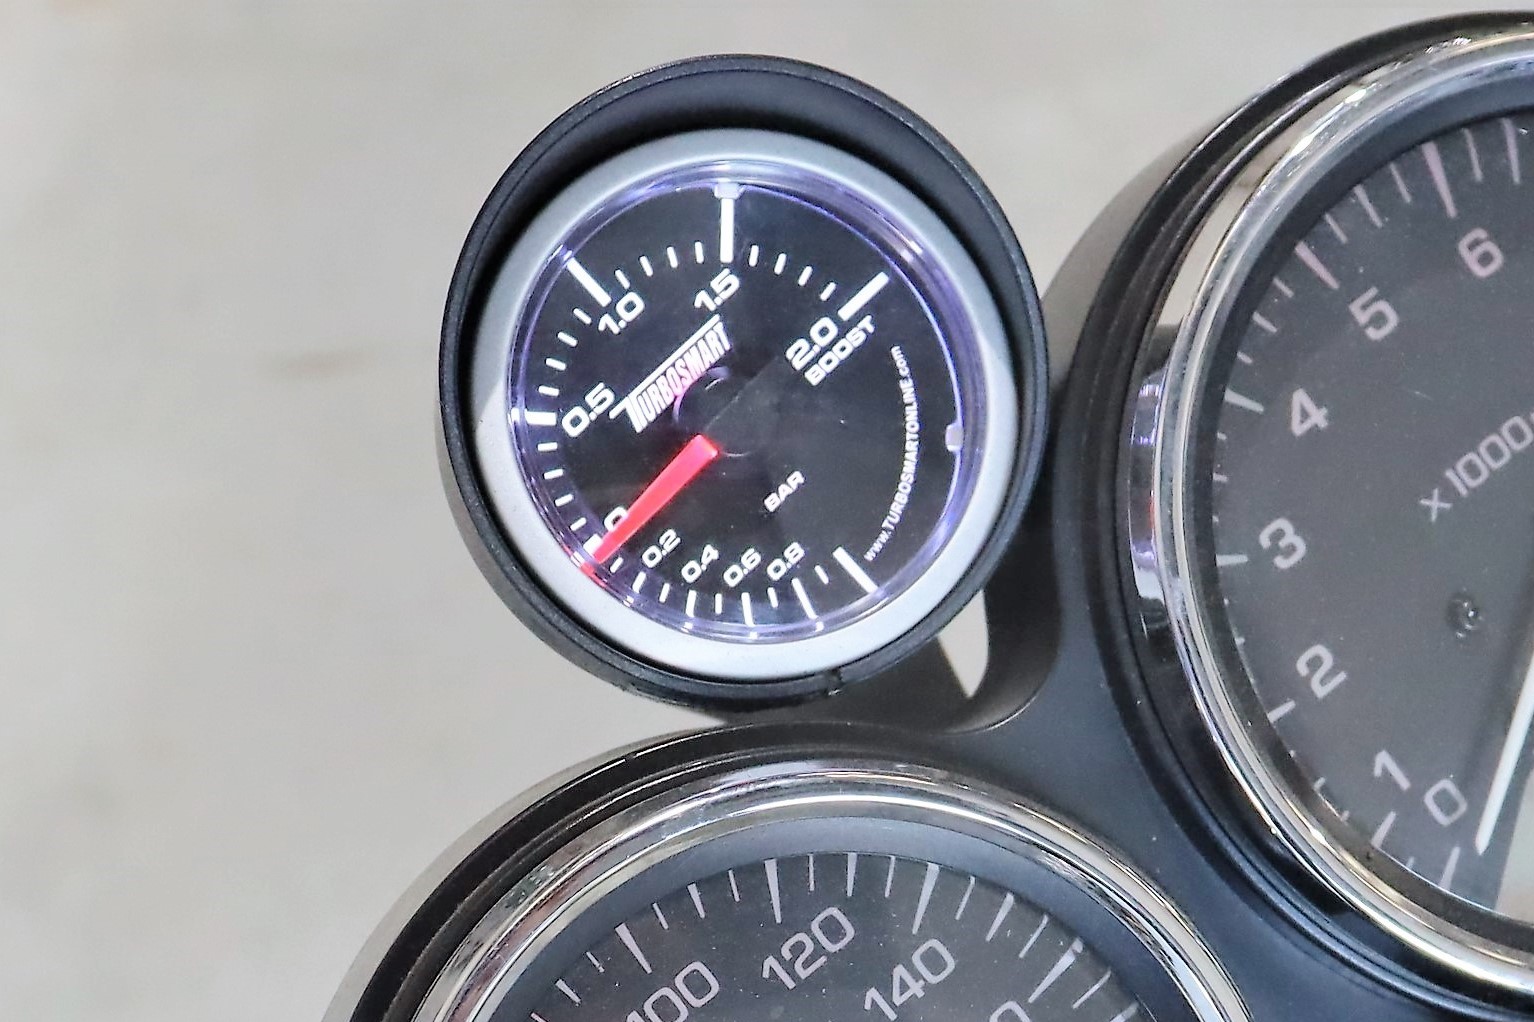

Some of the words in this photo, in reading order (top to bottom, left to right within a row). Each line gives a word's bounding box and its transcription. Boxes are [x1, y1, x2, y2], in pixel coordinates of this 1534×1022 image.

[1457, 227, 1505, 278] 6
[693, 269, 741, 311] 1.5
[1347, 286, 1400, 341] 5
[598, 297, 645, 336] 1.0
[786, 316, 839, 370] 2.0
[804, 314, 876, 387] BOOST
[609, 315, 732, 434] TURBOSMART
[560, 382, 617, 438] 0.5
[1287, 387, 1332, 437] 4
[763, 471, 805, 513] BAR
[640, 529, 681, 568] 0.2
[681, 545, 720, 584] 0.4
[723, 549, 762, 587] 0.6
[766, 542, 806, 582] 0.8
[1258, 517, 1307, 570] 3
[1295, 643, 1348, 700] 2
[1373, 748, 1413, 793] 1
[1422, 777, 1469, 827] 0
[760, 906, 856, 991] 120
[863, 937, 956, 1022] 140
